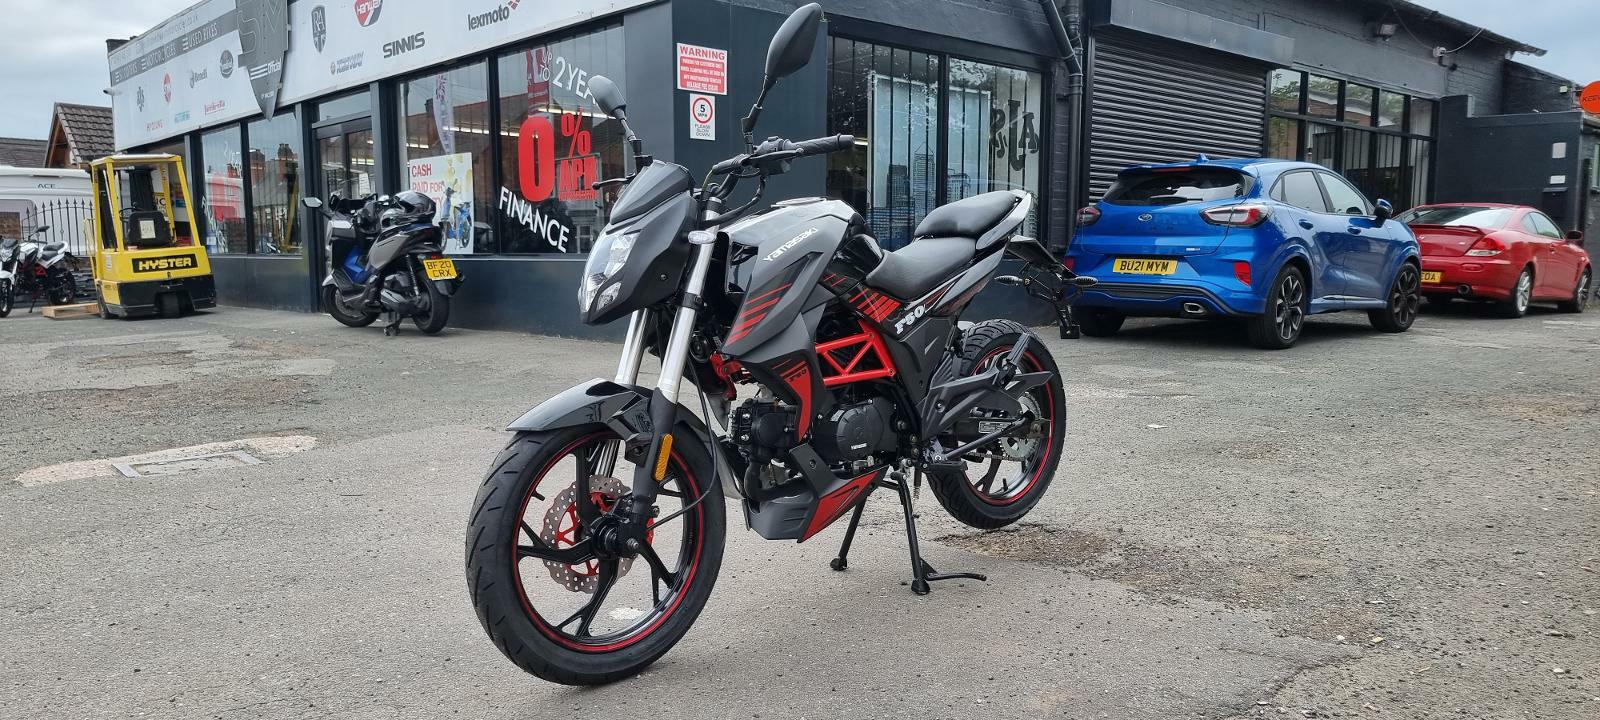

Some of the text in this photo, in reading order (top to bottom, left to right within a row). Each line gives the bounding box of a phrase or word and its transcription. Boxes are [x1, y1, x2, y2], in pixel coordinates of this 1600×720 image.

[467, 4, 510, 31] lexmoto
[188, 29, 203, 48] USED
[382, 31, 426, 59] SINNIS
[680, 45, 725, 60] WARNING
[552, 56, 566, 88] 2
[699, 104, 706, 113] 5
[412, 164, 432, 178] CASH
[559, 157, 598, 191] APR
[412, 181, 443, 193] PAID FOR
[499, 186, 569, 253] FINANCE
[138, 257, 192, 271] HYSTER
[1120, 260, 1170, 272] BU21 MYM
[432, 269, 452, 278] CRX
